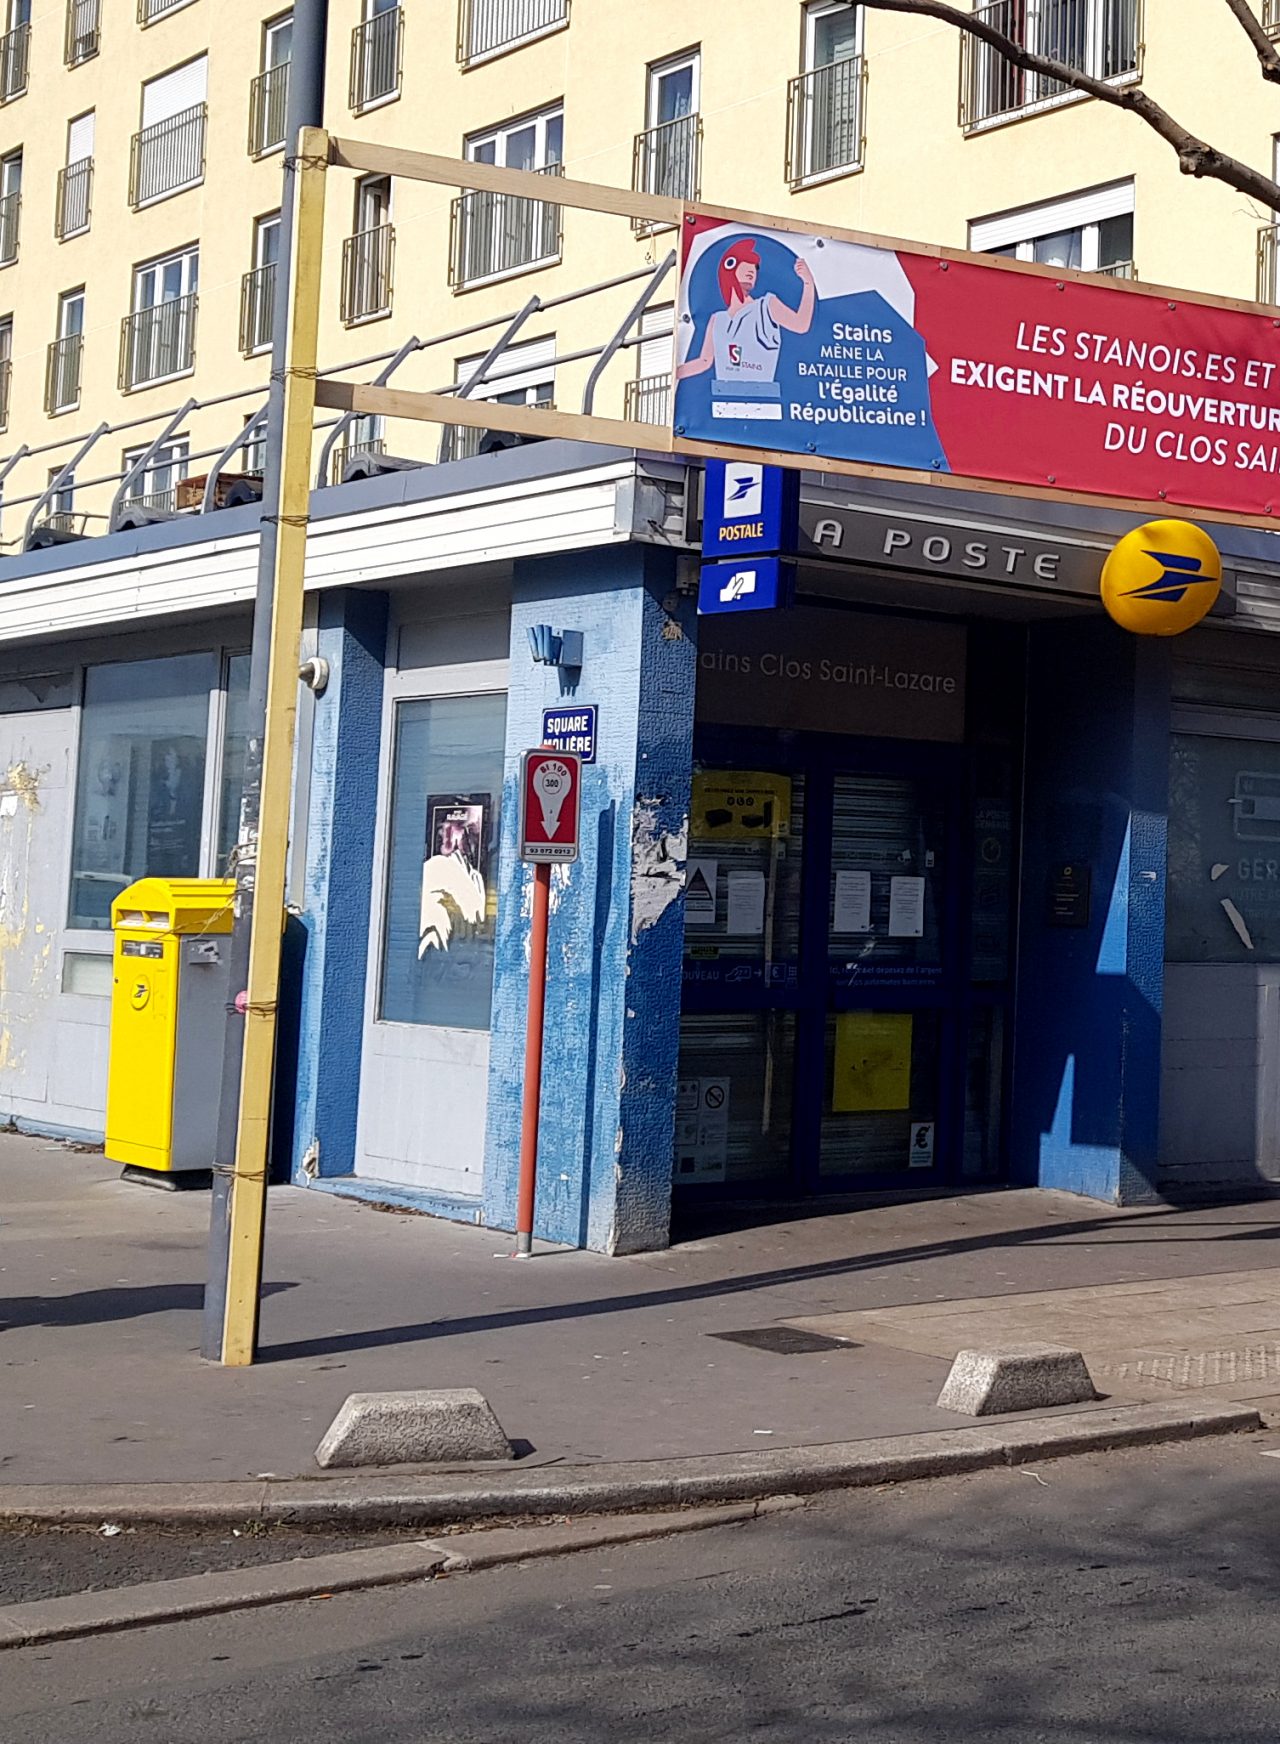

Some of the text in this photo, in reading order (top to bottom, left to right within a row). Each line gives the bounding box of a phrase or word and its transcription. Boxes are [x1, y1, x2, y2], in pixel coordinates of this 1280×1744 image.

[832, 322, 893, 344] Stains
[820, 343, 884, 361] MÈNE LA
[1016, 322, 1066, 356] LES
[1074, 332, 1237, 384] STANOIS.ES
[1244, 360, 1276, 389] ET
[798, 362, 907, 382] BATAILLE POUR
[951, 358, 1069, 400] EXIGENT
[1074, 377, 1107, 406] LA
[818, 379, 898, 404] l'Égalité
[789, 402, 916, 426] Républicaine
[1104, 422, 1147, 454] DU
[1155, 430, 1228, 466] CLOS
[718, 522, 764, 542] POSTALE
[883, 528, 1061, 580] POSTE
[701, 650, 957, 694] ains Clos Saint-Lazare
[547, 715, 589, 736] SQUARE
[553, 763, 568, 777] 100
[682, 969, 720, 981] OUVEAU
